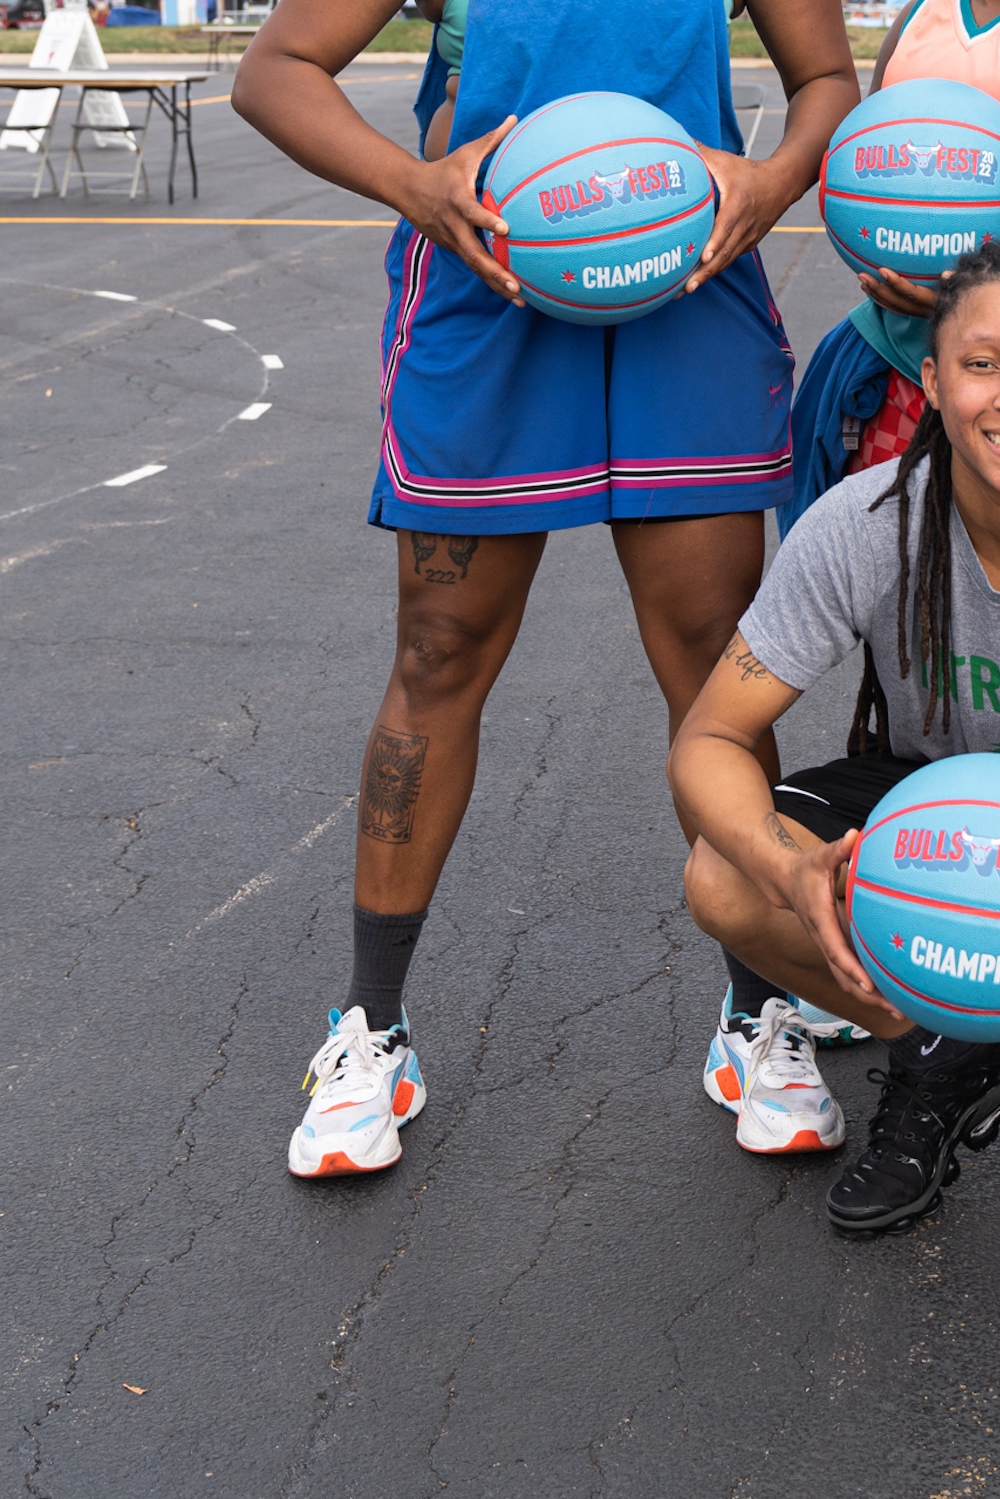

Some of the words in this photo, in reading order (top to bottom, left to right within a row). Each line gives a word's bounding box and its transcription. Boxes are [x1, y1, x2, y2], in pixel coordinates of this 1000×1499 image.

[854, 143, 910, 171] BULLS
[936, 147, 981, 175] FEST
[538, 175, 605, 218] BULLS
[628, 161, 671, 195] FEST
[875, 227, 976, 255] CHAMPION
[582, 246, 682, 288] CHAMPION
[425, 568, 456, 585] 222
[893, 828, 965, 861] BULLS
